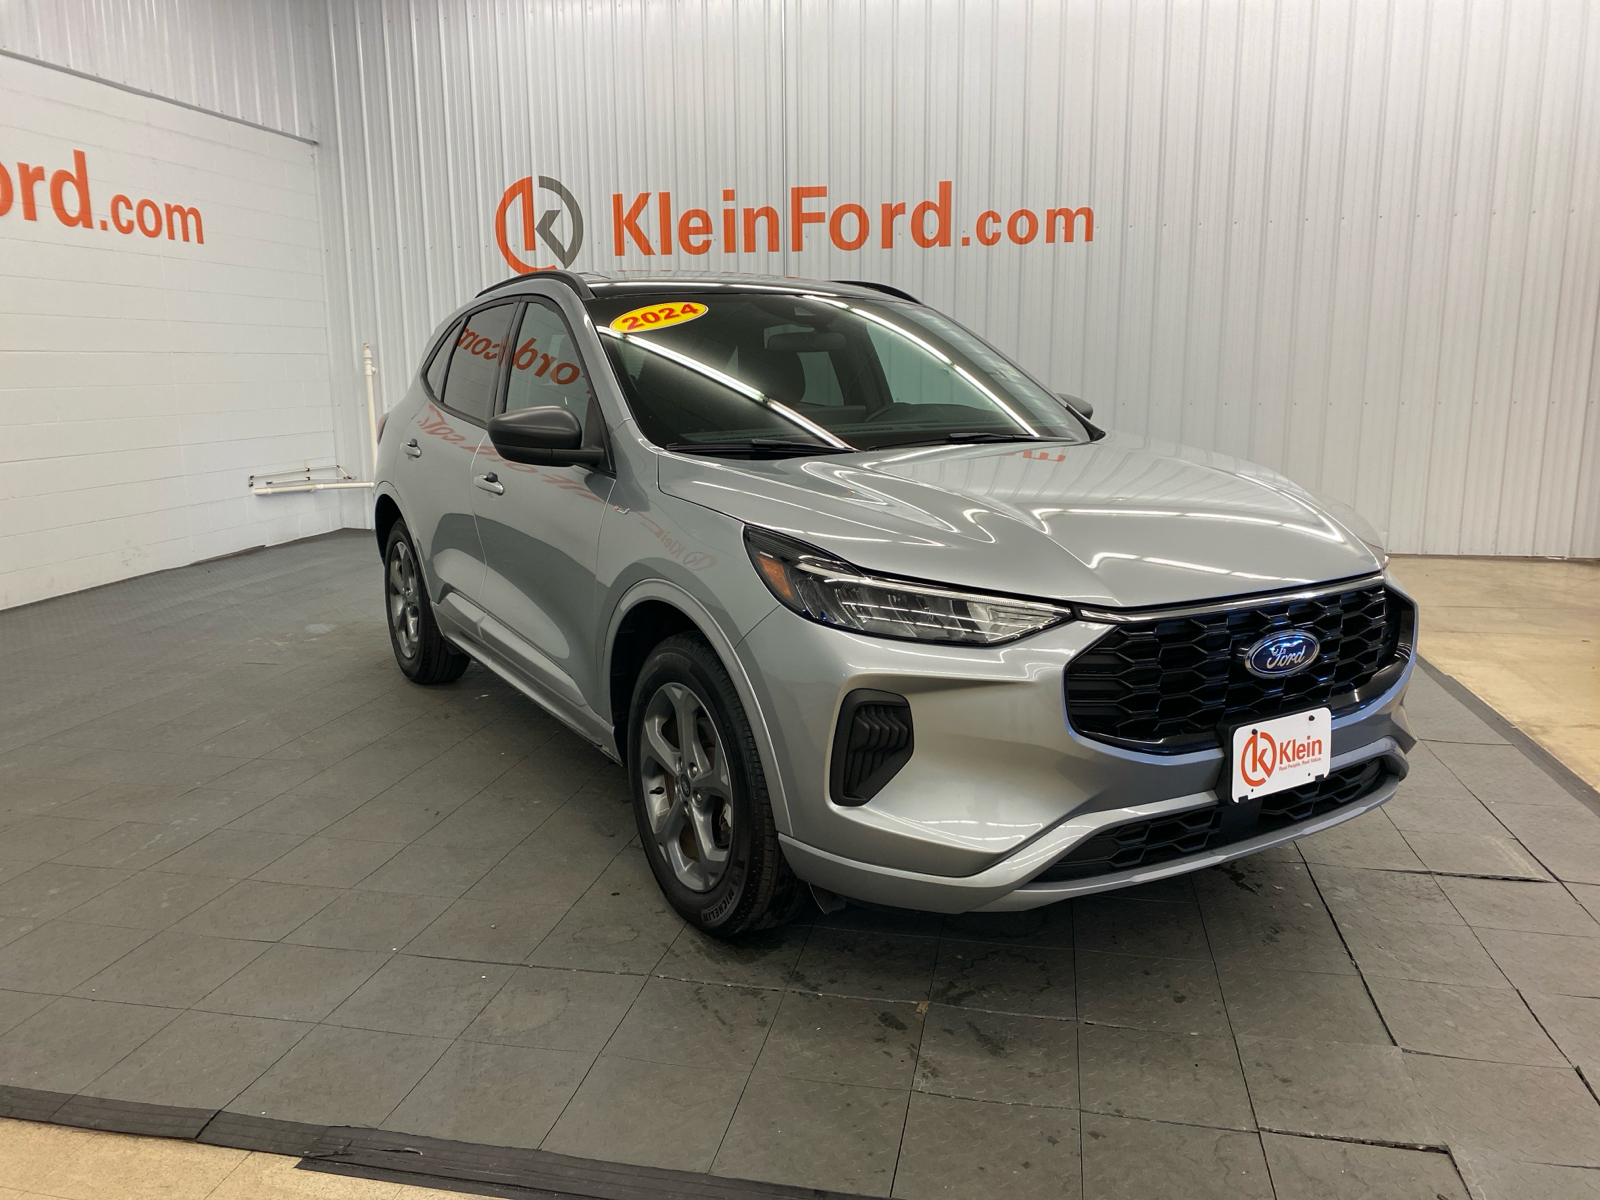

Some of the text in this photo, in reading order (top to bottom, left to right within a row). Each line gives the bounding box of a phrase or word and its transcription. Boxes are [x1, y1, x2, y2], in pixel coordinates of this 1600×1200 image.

[612, 181, 1093, 256] KleinFord.com
[621, 303, 699, 331] 2024
[1266, 642, 1307, 669] Ford
[1279, 735, 1322, 765] Klein
[703, 886, 735, 921] MICHELIN
